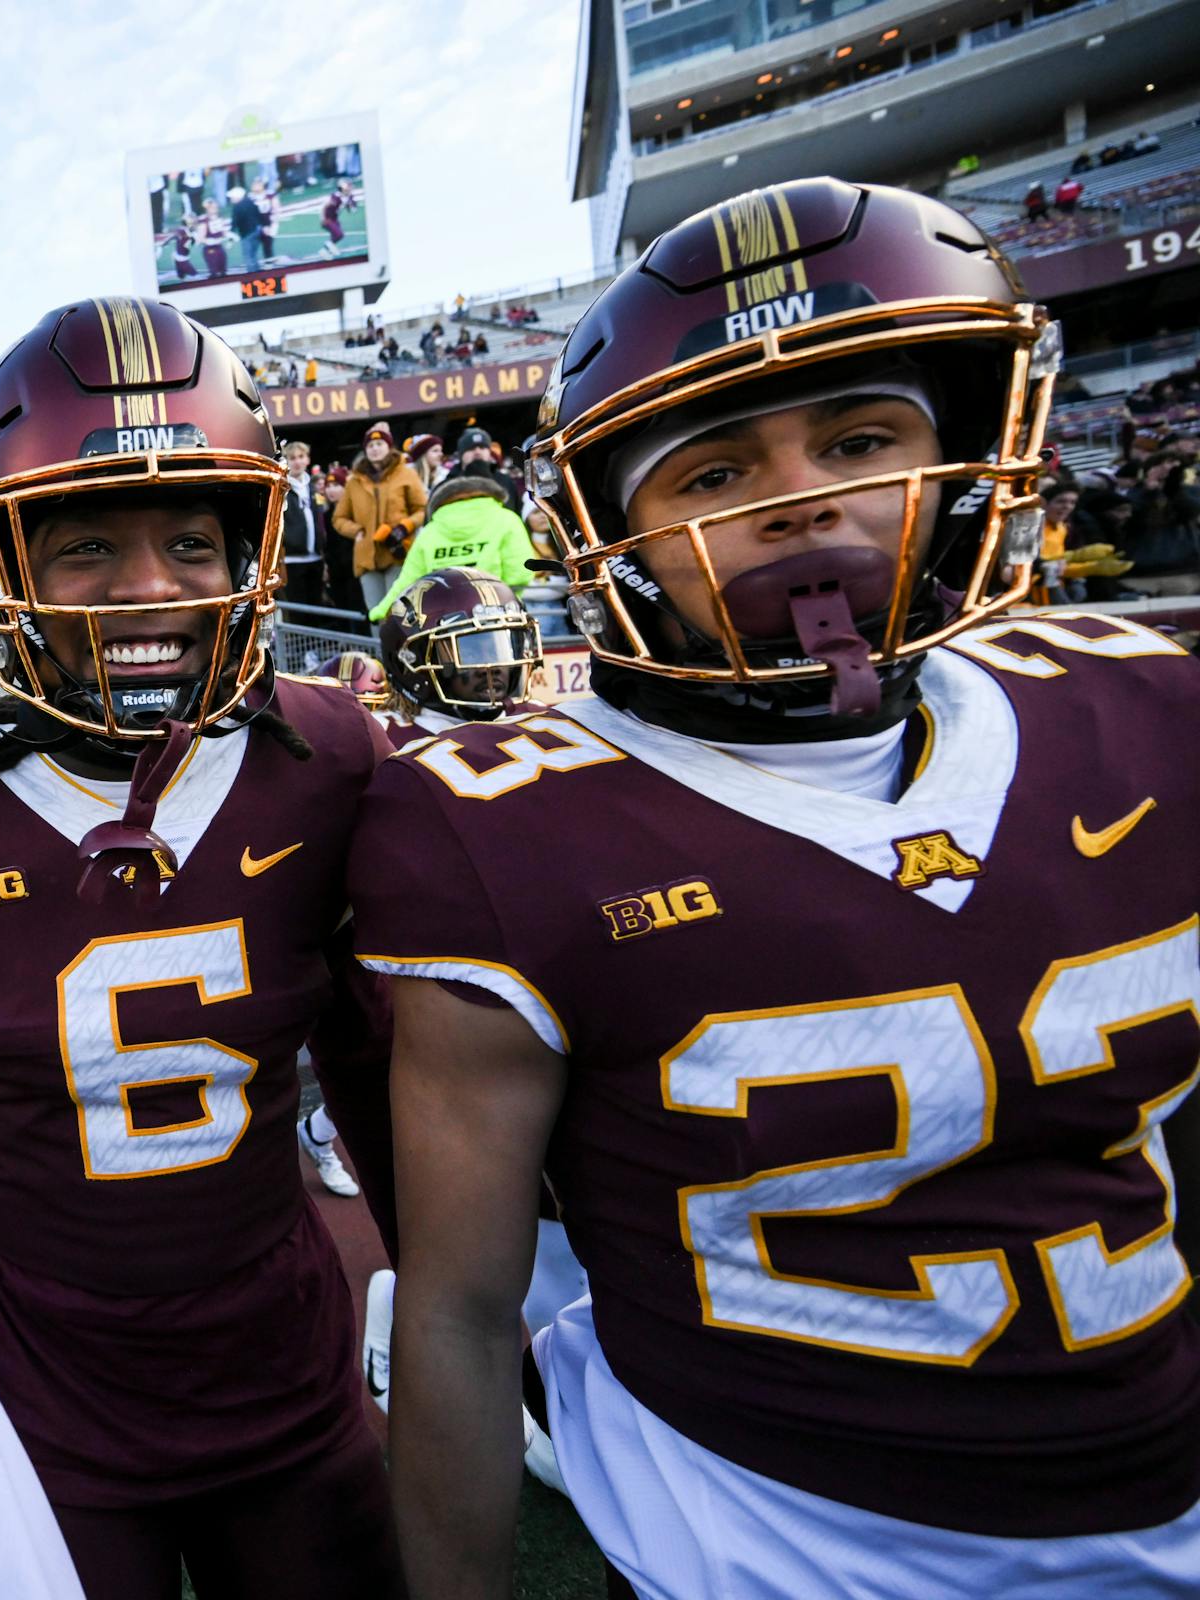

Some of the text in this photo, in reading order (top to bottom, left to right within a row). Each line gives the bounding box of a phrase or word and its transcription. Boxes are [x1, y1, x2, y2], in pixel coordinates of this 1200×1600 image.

[725, 292, 814, 343] ROW
[272, 366, 544, 417] TIONAL CHAMP
[117, 427, 174, 453] ROW
[434, 541, 489, 560] BEST
[122, 692, 173, 706] Riddell
[56, 917, 259, 1180] 6
[659, 912, 1200, 1367] 23
